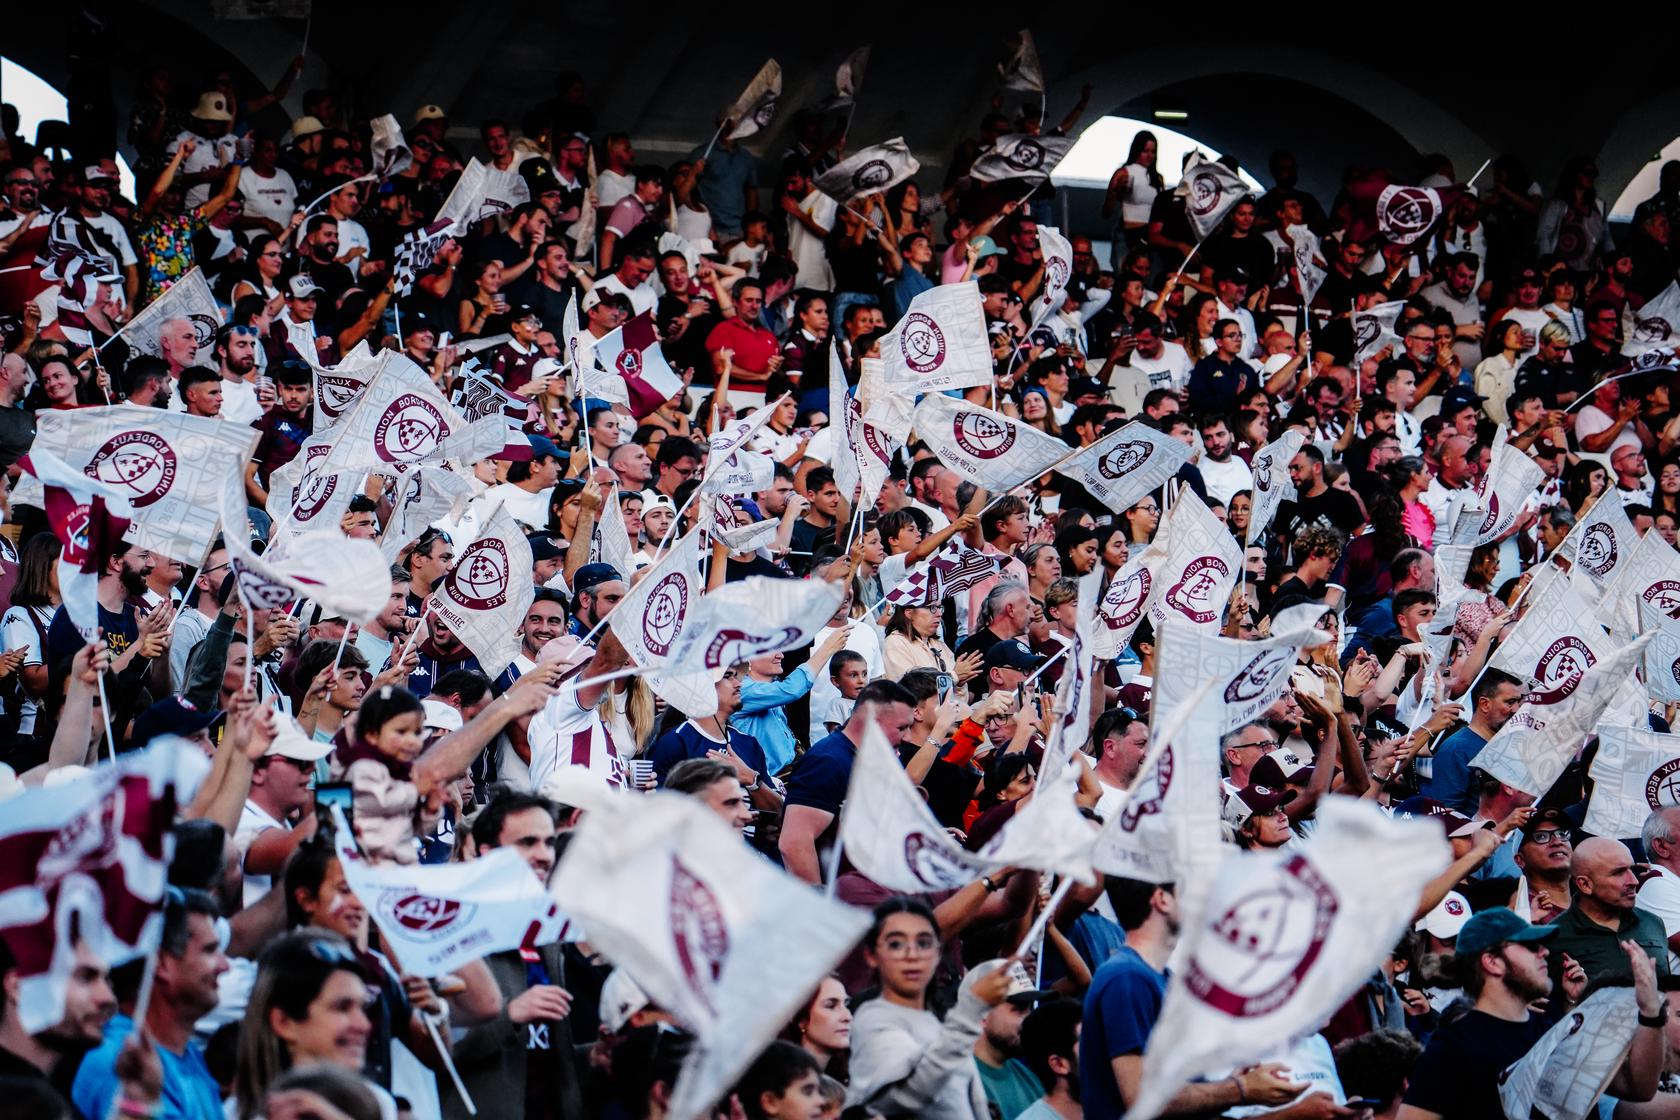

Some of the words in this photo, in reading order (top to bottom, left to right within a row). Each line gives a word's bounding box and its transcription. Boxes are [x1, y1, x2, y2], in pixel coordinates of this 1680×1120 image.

[376, 410, 395, 446] UNION
[398, 396, 443, 423] BORDEAUX
[1180, 560, 1203, 585] UNION
[1597, 559, 1615, 574] BEG
[449, 585, 470, 605] RUGBY
[486, 592, 507, 607] GLES
[1644, 586, 1659, 600] ION
[429, 597, 443, 610] CAP
[440, 606, 465, 628] INGELEC
[1540, 640, 1566, 665] UNION
[1569, 638, 1595, 666] BORDEA
